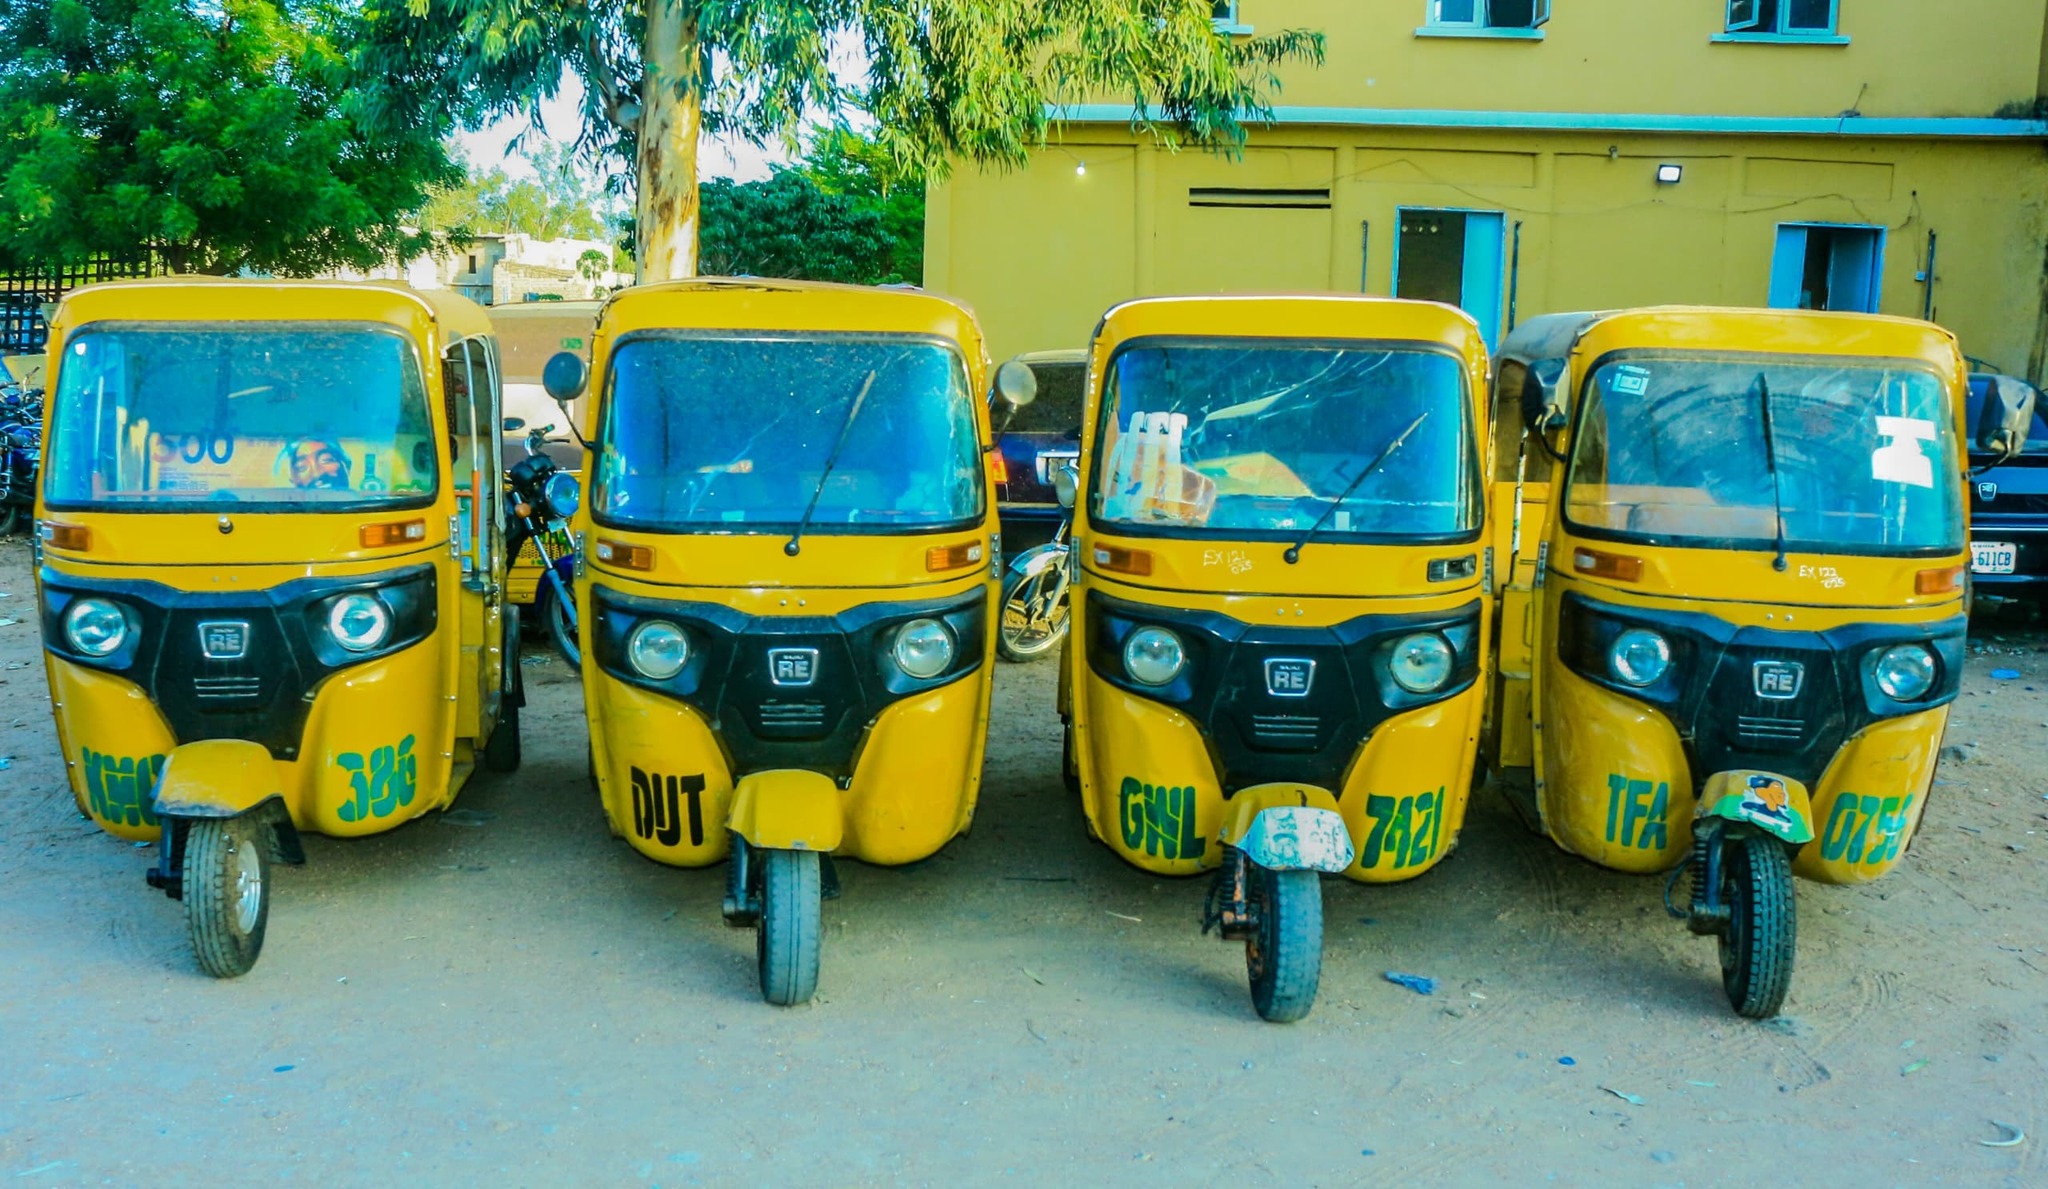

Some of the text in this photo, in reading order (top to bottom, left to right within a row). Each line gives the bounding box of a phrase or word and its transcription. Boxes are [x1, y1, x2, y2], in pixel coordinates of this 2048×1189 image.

[1203, 549, 1223, 566] EX
[1971, 551, 2012, 567] -611CB
[1798, 564, 1817, 580] EX
[209, 634, 241, 651] RE
[778, 660, 809, 678] RE
[1274, 670, 1305, 689] RE
[1761, 673, 1793, 691] RE
[336, 733, 416, 822] 386
[630, 765, 706, 847] DUT
[1605, 773, 1668, 851] TFA
[1120, 776, 1206, 860] GWL
